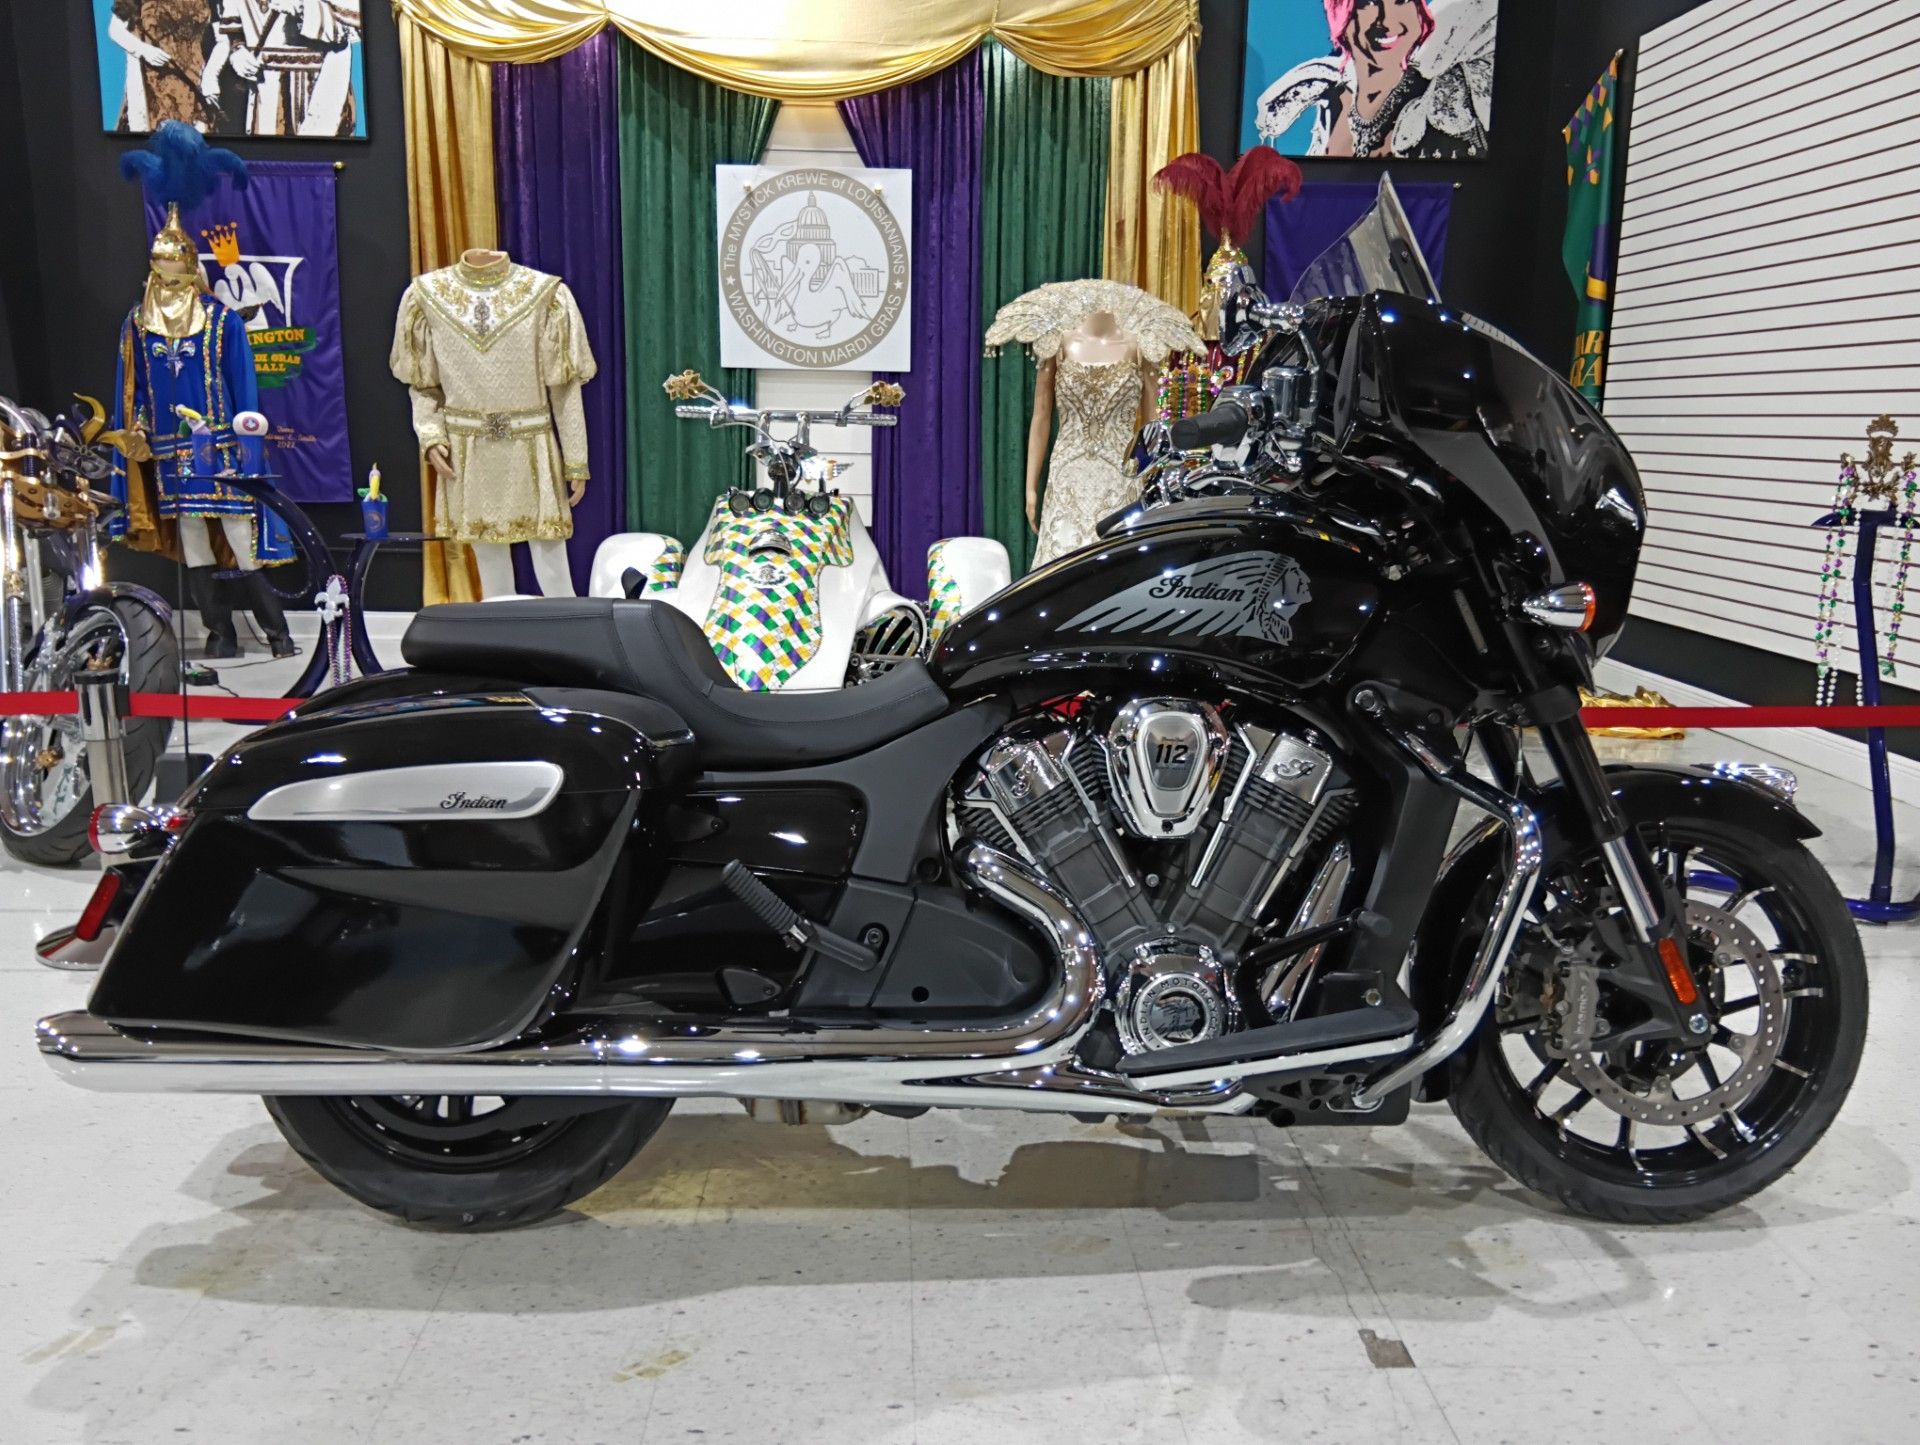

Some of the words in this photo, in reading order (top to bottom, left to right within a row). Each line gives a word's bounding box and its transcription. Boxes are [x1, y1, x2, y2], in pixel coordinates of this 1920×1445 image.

[775, 172, 829, 191] KREWE
[831, 178, 847, 190] of
[727, 183, 776, 242] MYSTICK
[847, 182, 905, 275] LOUISIANIANS
[723, 243, 738, 271] The
[247, 329, 305, 345] INGTON
[728, 290, 818, 364] WASHINGTON
[822, 337, 873, 364] MARDI
[871, 294, 902, 337] GRAS
[1148, 575, 1246, 603] Indian
[1155, 743, 1189, 764] 112
[440, 792, 508, 809] Indian
[1139, 991, 1156, 1042] INDIAN
